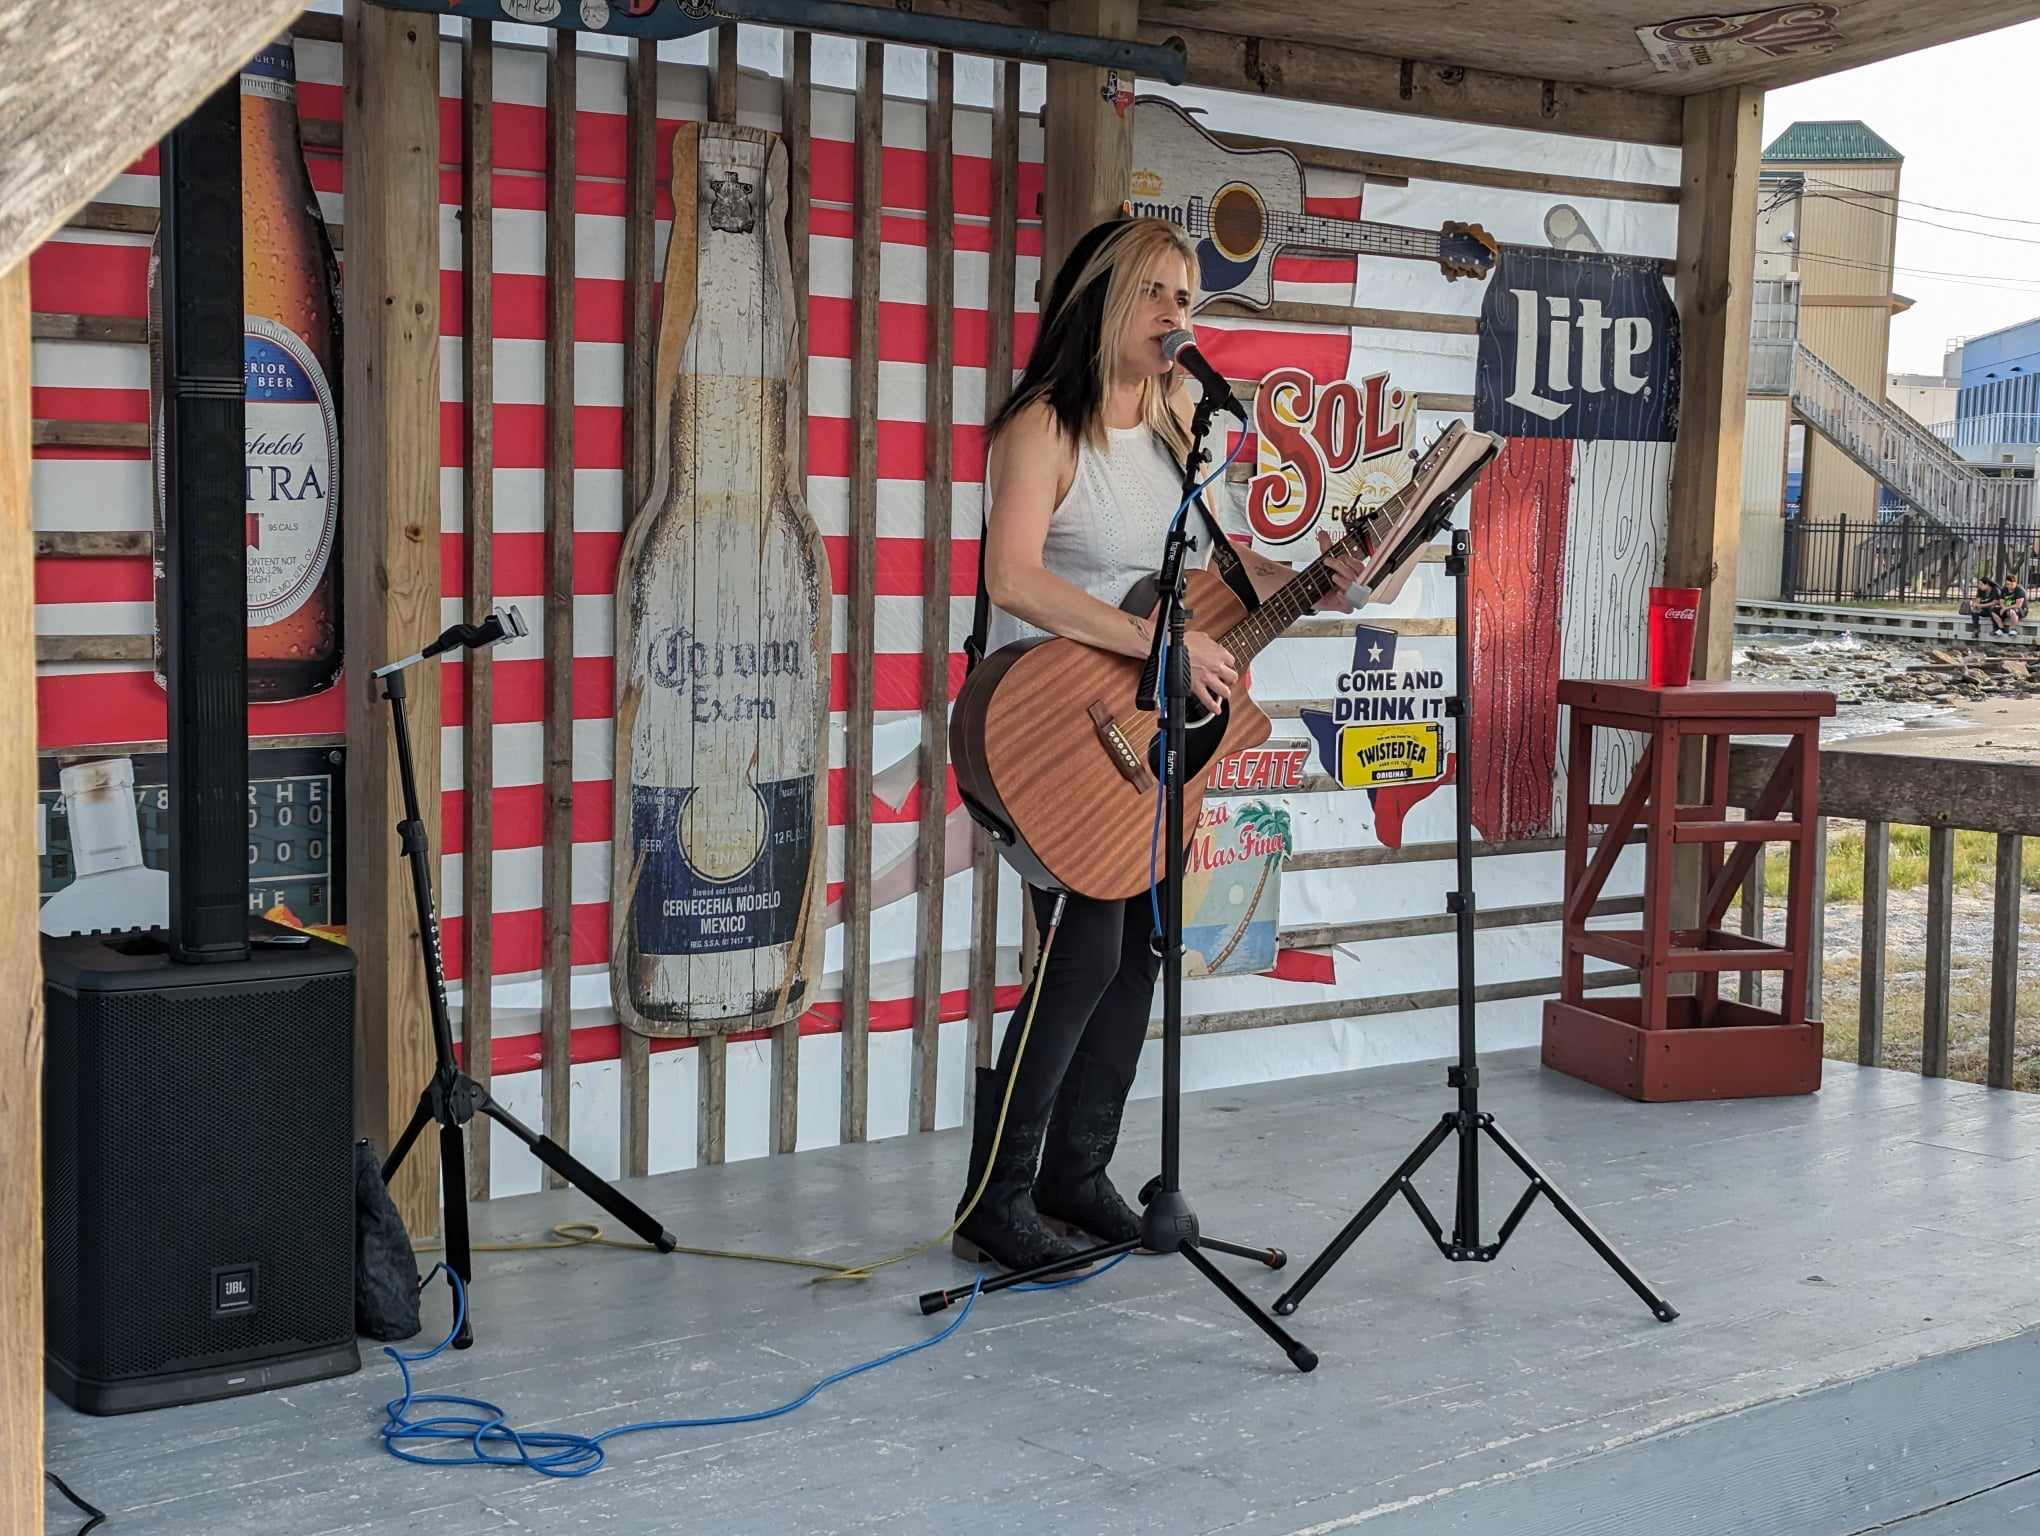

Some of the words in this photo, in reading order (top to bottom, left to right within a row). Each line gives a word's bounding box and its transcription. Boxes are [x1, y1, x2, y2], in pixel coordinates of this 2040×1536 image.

[1505, 288, 1653, 420] Lite
[244, 362, 287, 374] RIOR
[258, 377, 294, 388] BEER
[244, 432, 305, 456] chelob
[1247, 367, 1403, 546] SOL
[245, 463, 323, 501] TRA
[247, 557, 279, 566] ONTENT
[248, 566, 264, 575] HAN
[248, 575, 271, 585] EIGHT
[1338, 673, 1396, 693] COME
[1403, 671, 1443, 690] AND
[1335, 698, 1416, 721] DRINK
[1422, 698, 1442, 718] IT
[1357, 741, 1405, 768] TWISTED
[1406, 740, 1427, 764] TEA
[1376, 770, 1408, 780] ORIGINAL
[276, 783, 293, 803] H
[309, 782, 321, 801] E
[774, 831, 785, 845] 12
[1185, 834, 1235, 874] Mas
[1238, 823, 1285, 860] Fina
[663, 897, 734, 917] CERVECERIA
[737, 890, 781, 912] MODELO
[700, 915, 746, 935] MEXICO
[225, 1281, 246, 1296] JBL
